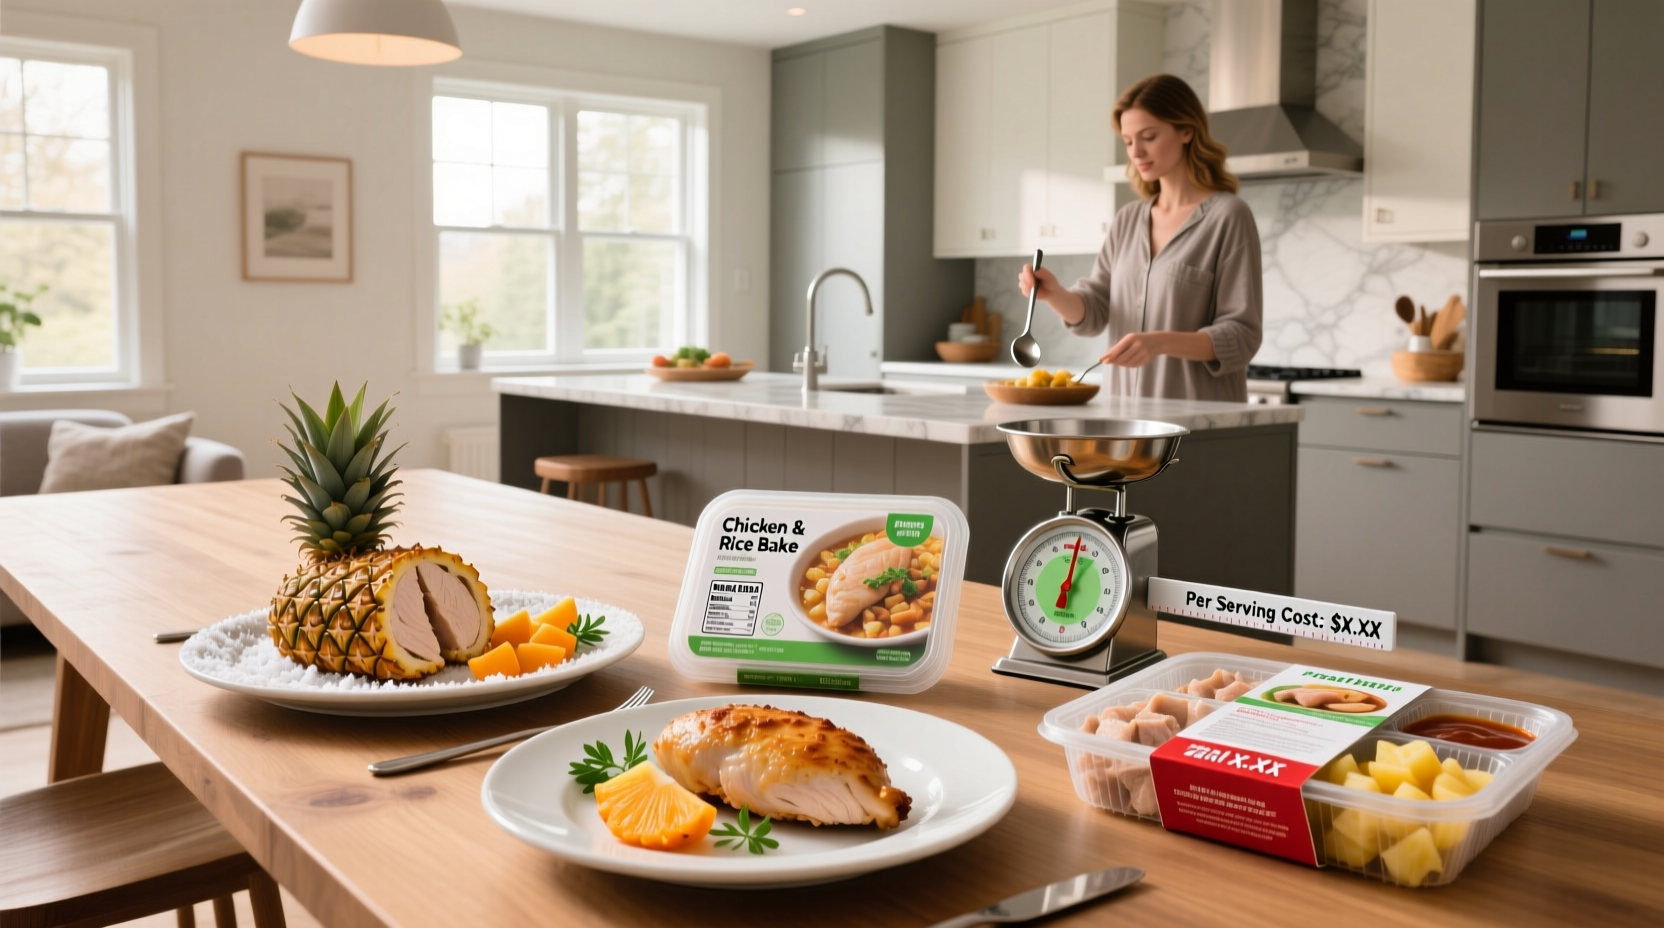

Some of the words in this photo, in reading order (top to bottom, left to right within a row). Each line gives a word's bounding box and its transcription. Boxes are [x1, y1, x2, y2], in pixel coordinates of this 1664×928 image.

[722, 517, 788, 535] Chicken
[791, 519, 805, 536] &
[718, 535, 754, 552] Rice
[757, 536, 799, 554] Bake
[1186, 590, 1212, 609] Per
[1216, 595, 1276, 624] Serving
[1281, 606, 1325, 629] Cost:
[1330, 612, 1382, 640] $X.XX
[1227, 753, 1287, 777] X.XX
